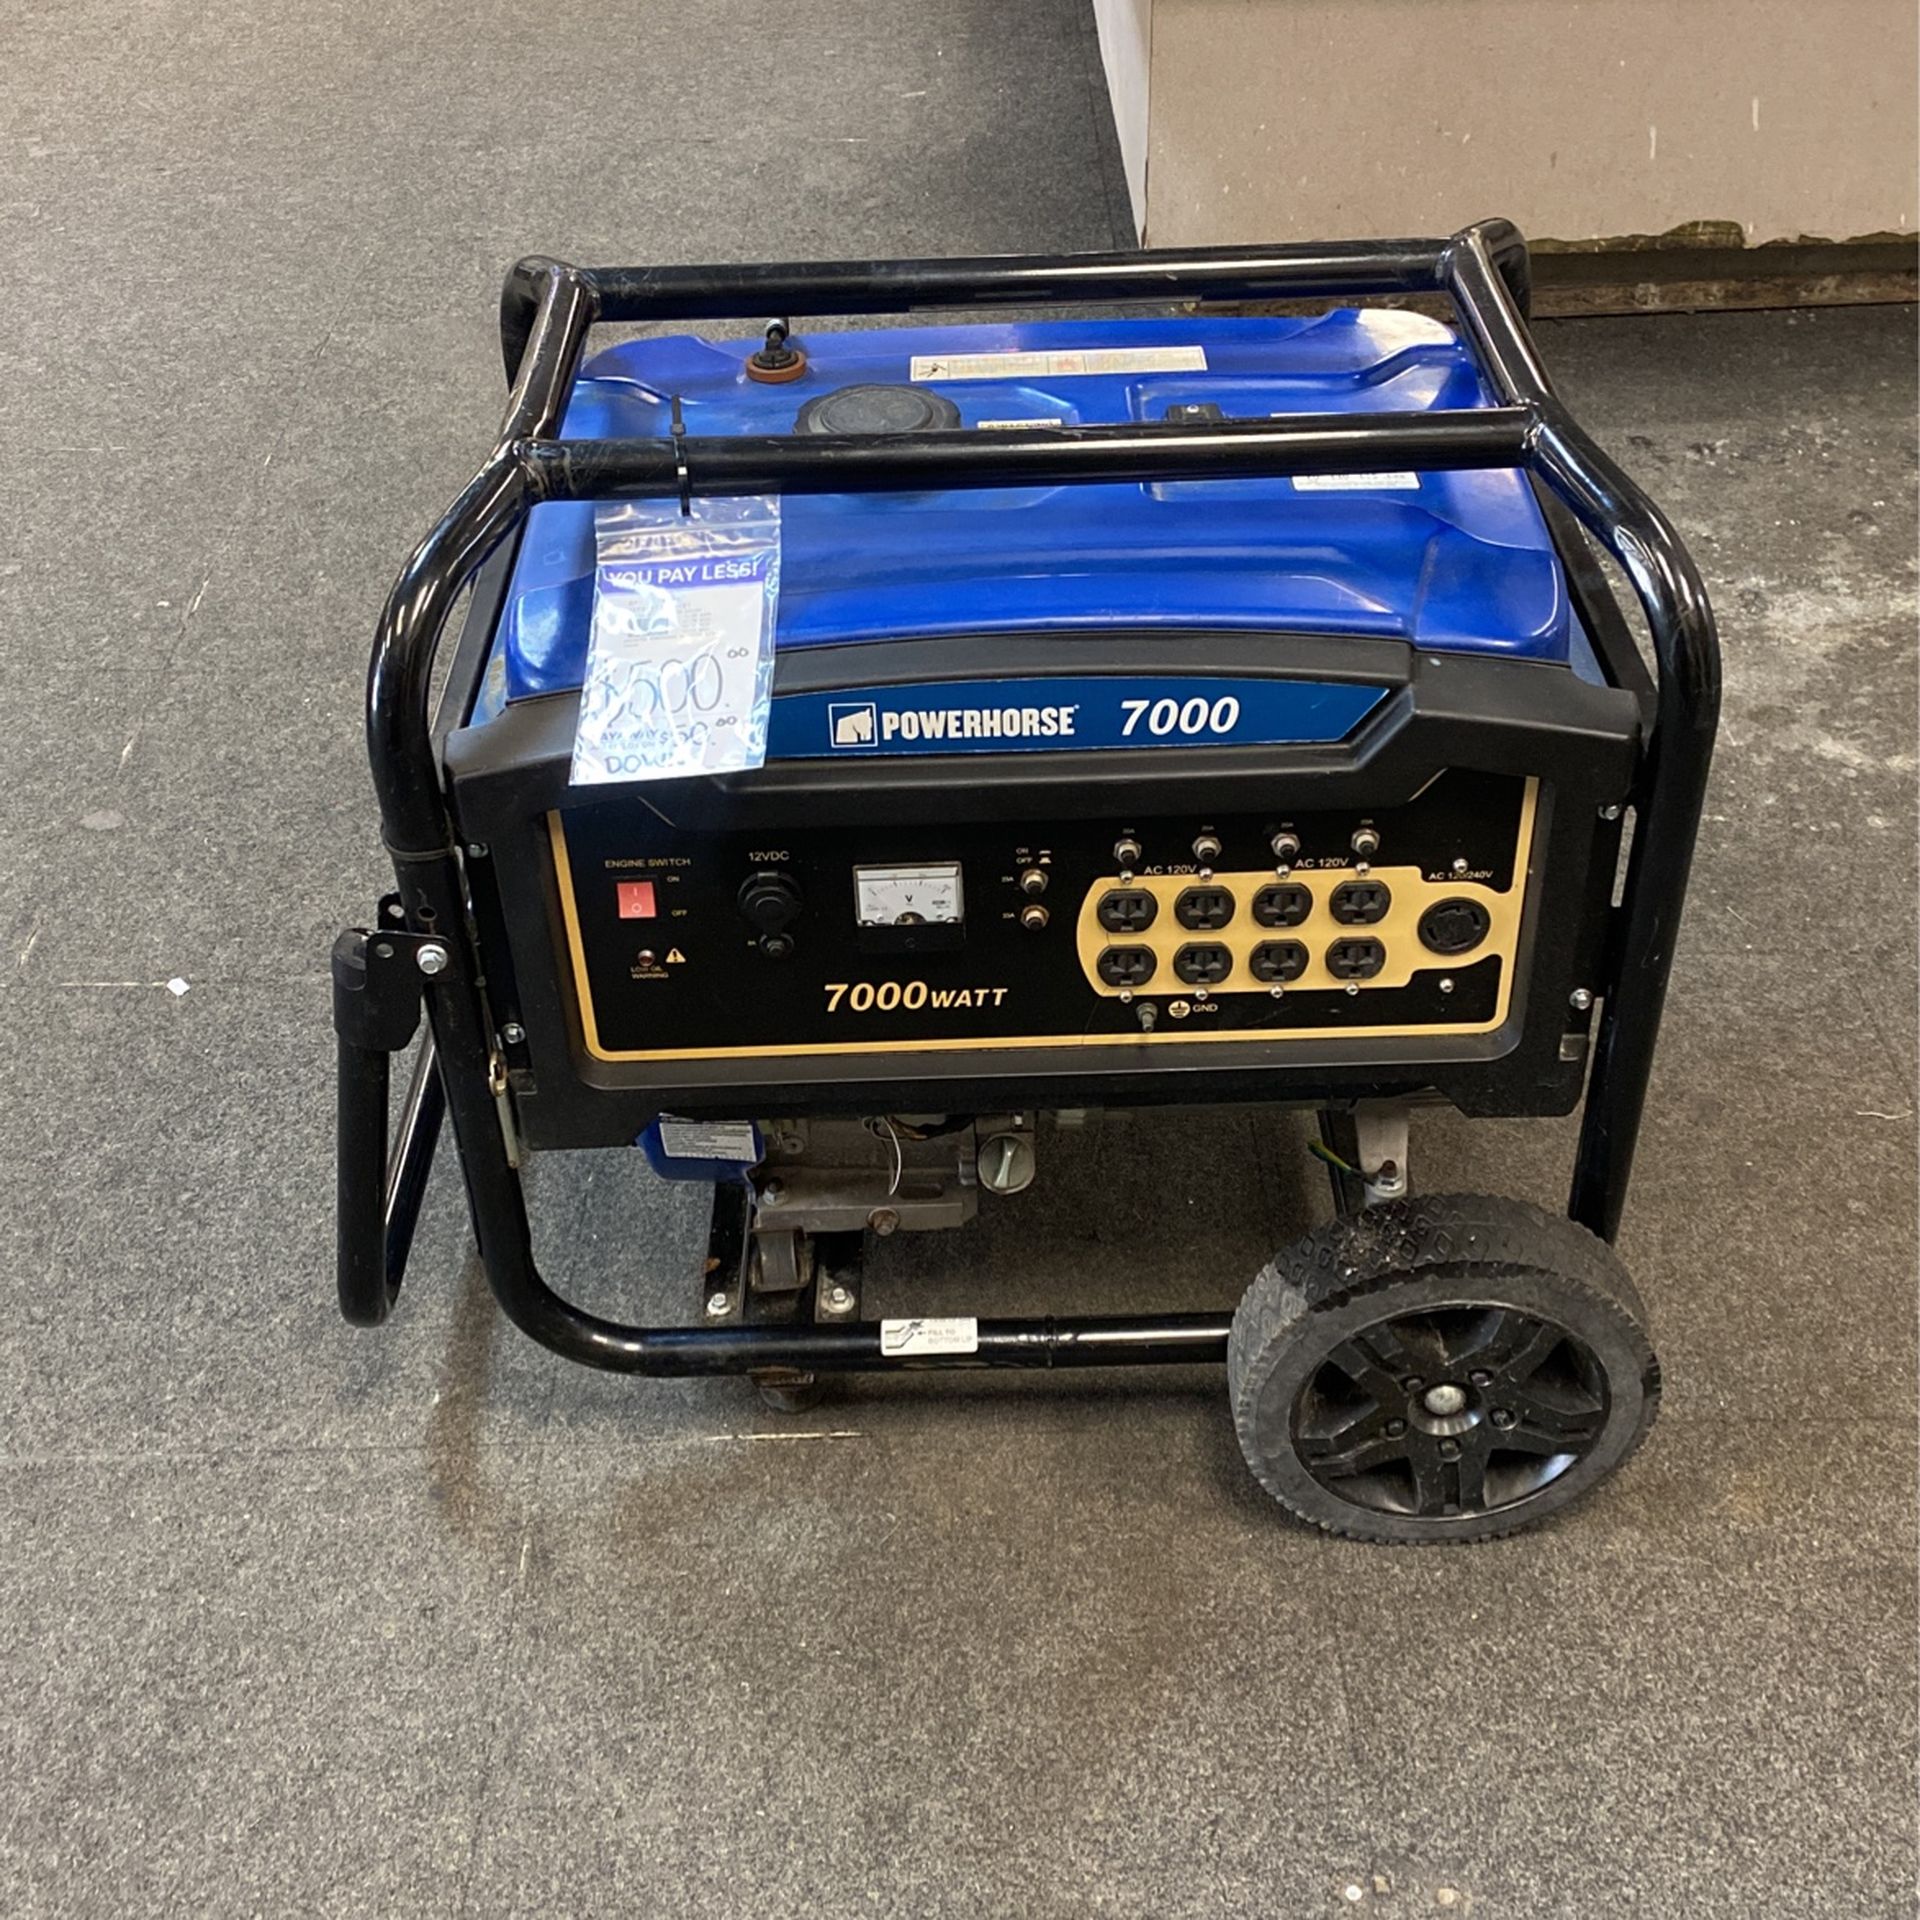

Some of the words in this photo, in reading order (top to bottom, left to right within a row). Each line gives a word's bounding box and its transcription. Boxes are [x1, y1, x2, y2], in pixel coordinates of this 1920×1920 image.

[608, 569, 652, 585] YOU
[657, 565, 698, 584] PAY
[881, 705, 1078, 740] POWERHORSE
[1120, 695, 1241, 736] 7000
[749, 851, 790, 861] 12VDC
[604, 859, 646, 869] ENGINE
[647, 857, 692, 868] SWITCH
[1295, 858, 1315, 869] AC
[1318, 857, 1350, 868] 120V
[1143, 865, 1163, 875] AC
[1166, 864, 1198, 875] 120V
[666, 875, 680, 883] ON
[1428, 872, 1445, 880] AC
[671, 909, 688, 917] OFF
[1192, 1002, 1219, 1013] GND
